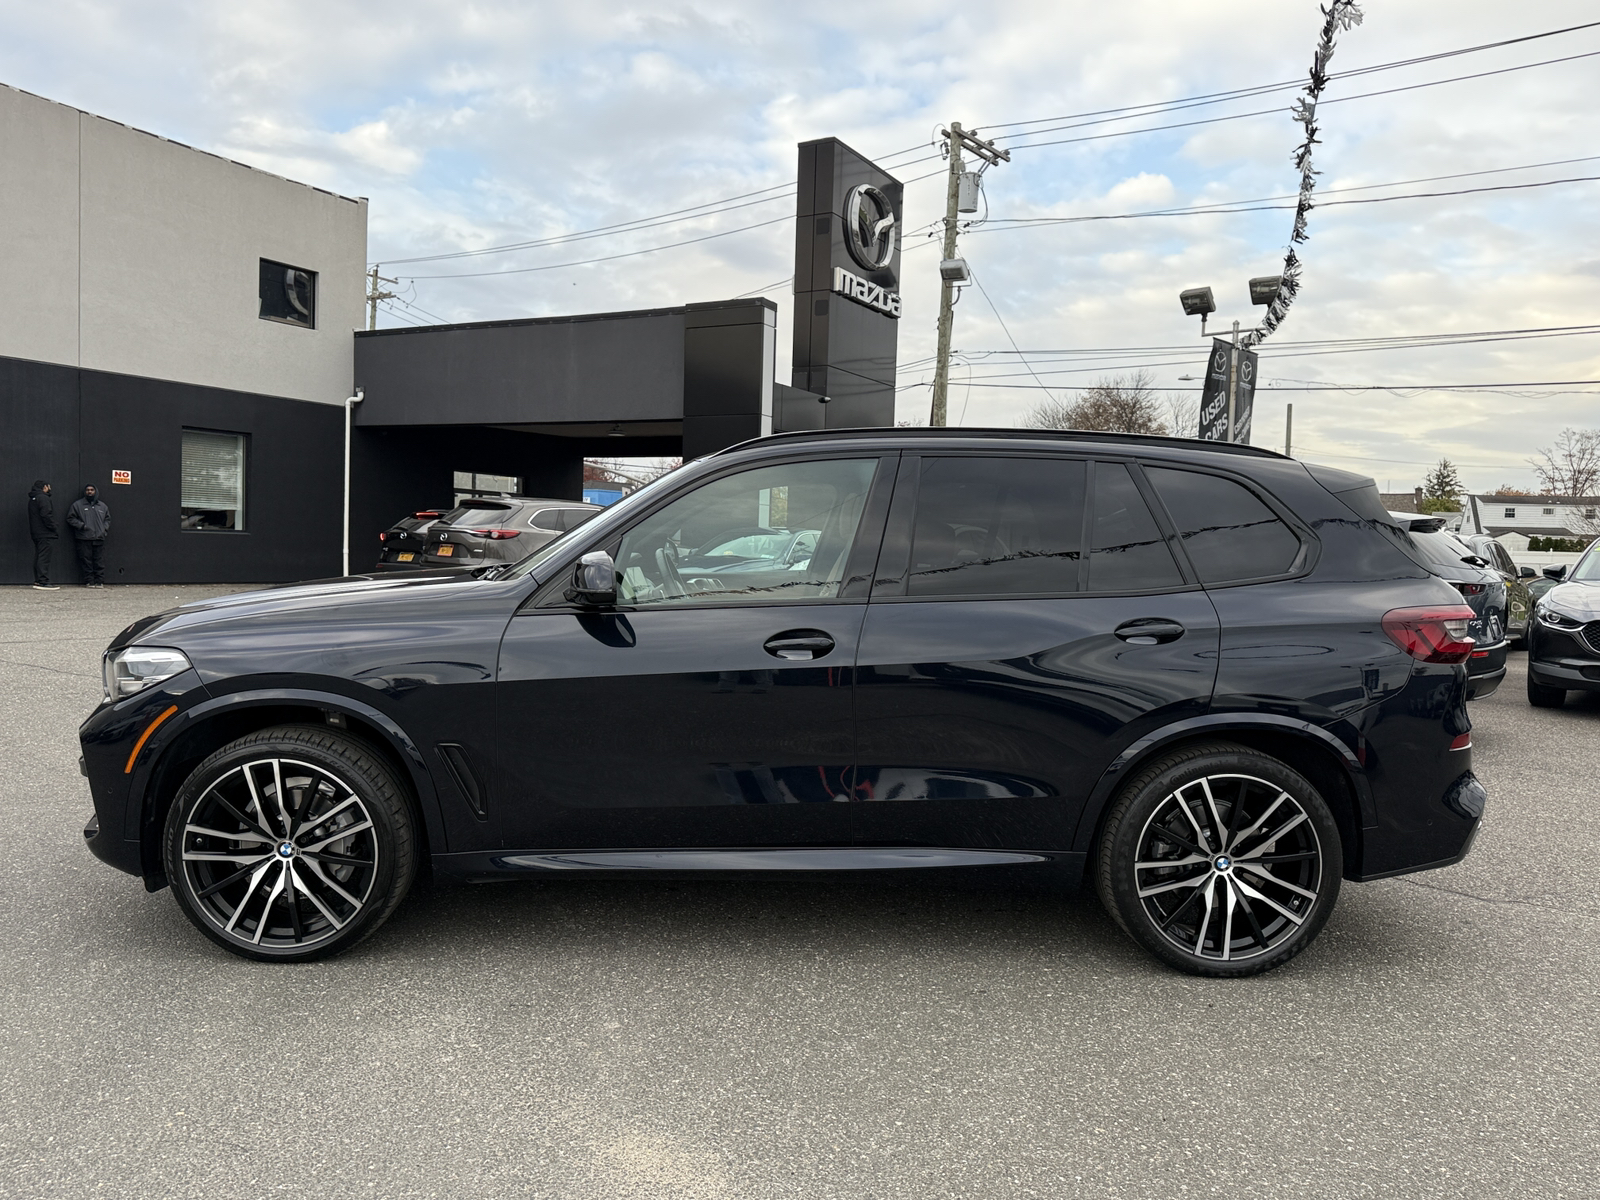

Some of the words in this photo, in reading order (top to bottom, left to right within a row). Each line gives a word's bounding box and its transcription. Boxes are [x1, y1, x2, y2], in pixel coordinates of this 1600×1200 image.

[833, 266, 902, 318] mazda
[1201, 390, 1226, 426] USED
[1205, 413, 1228, 440] CARS
